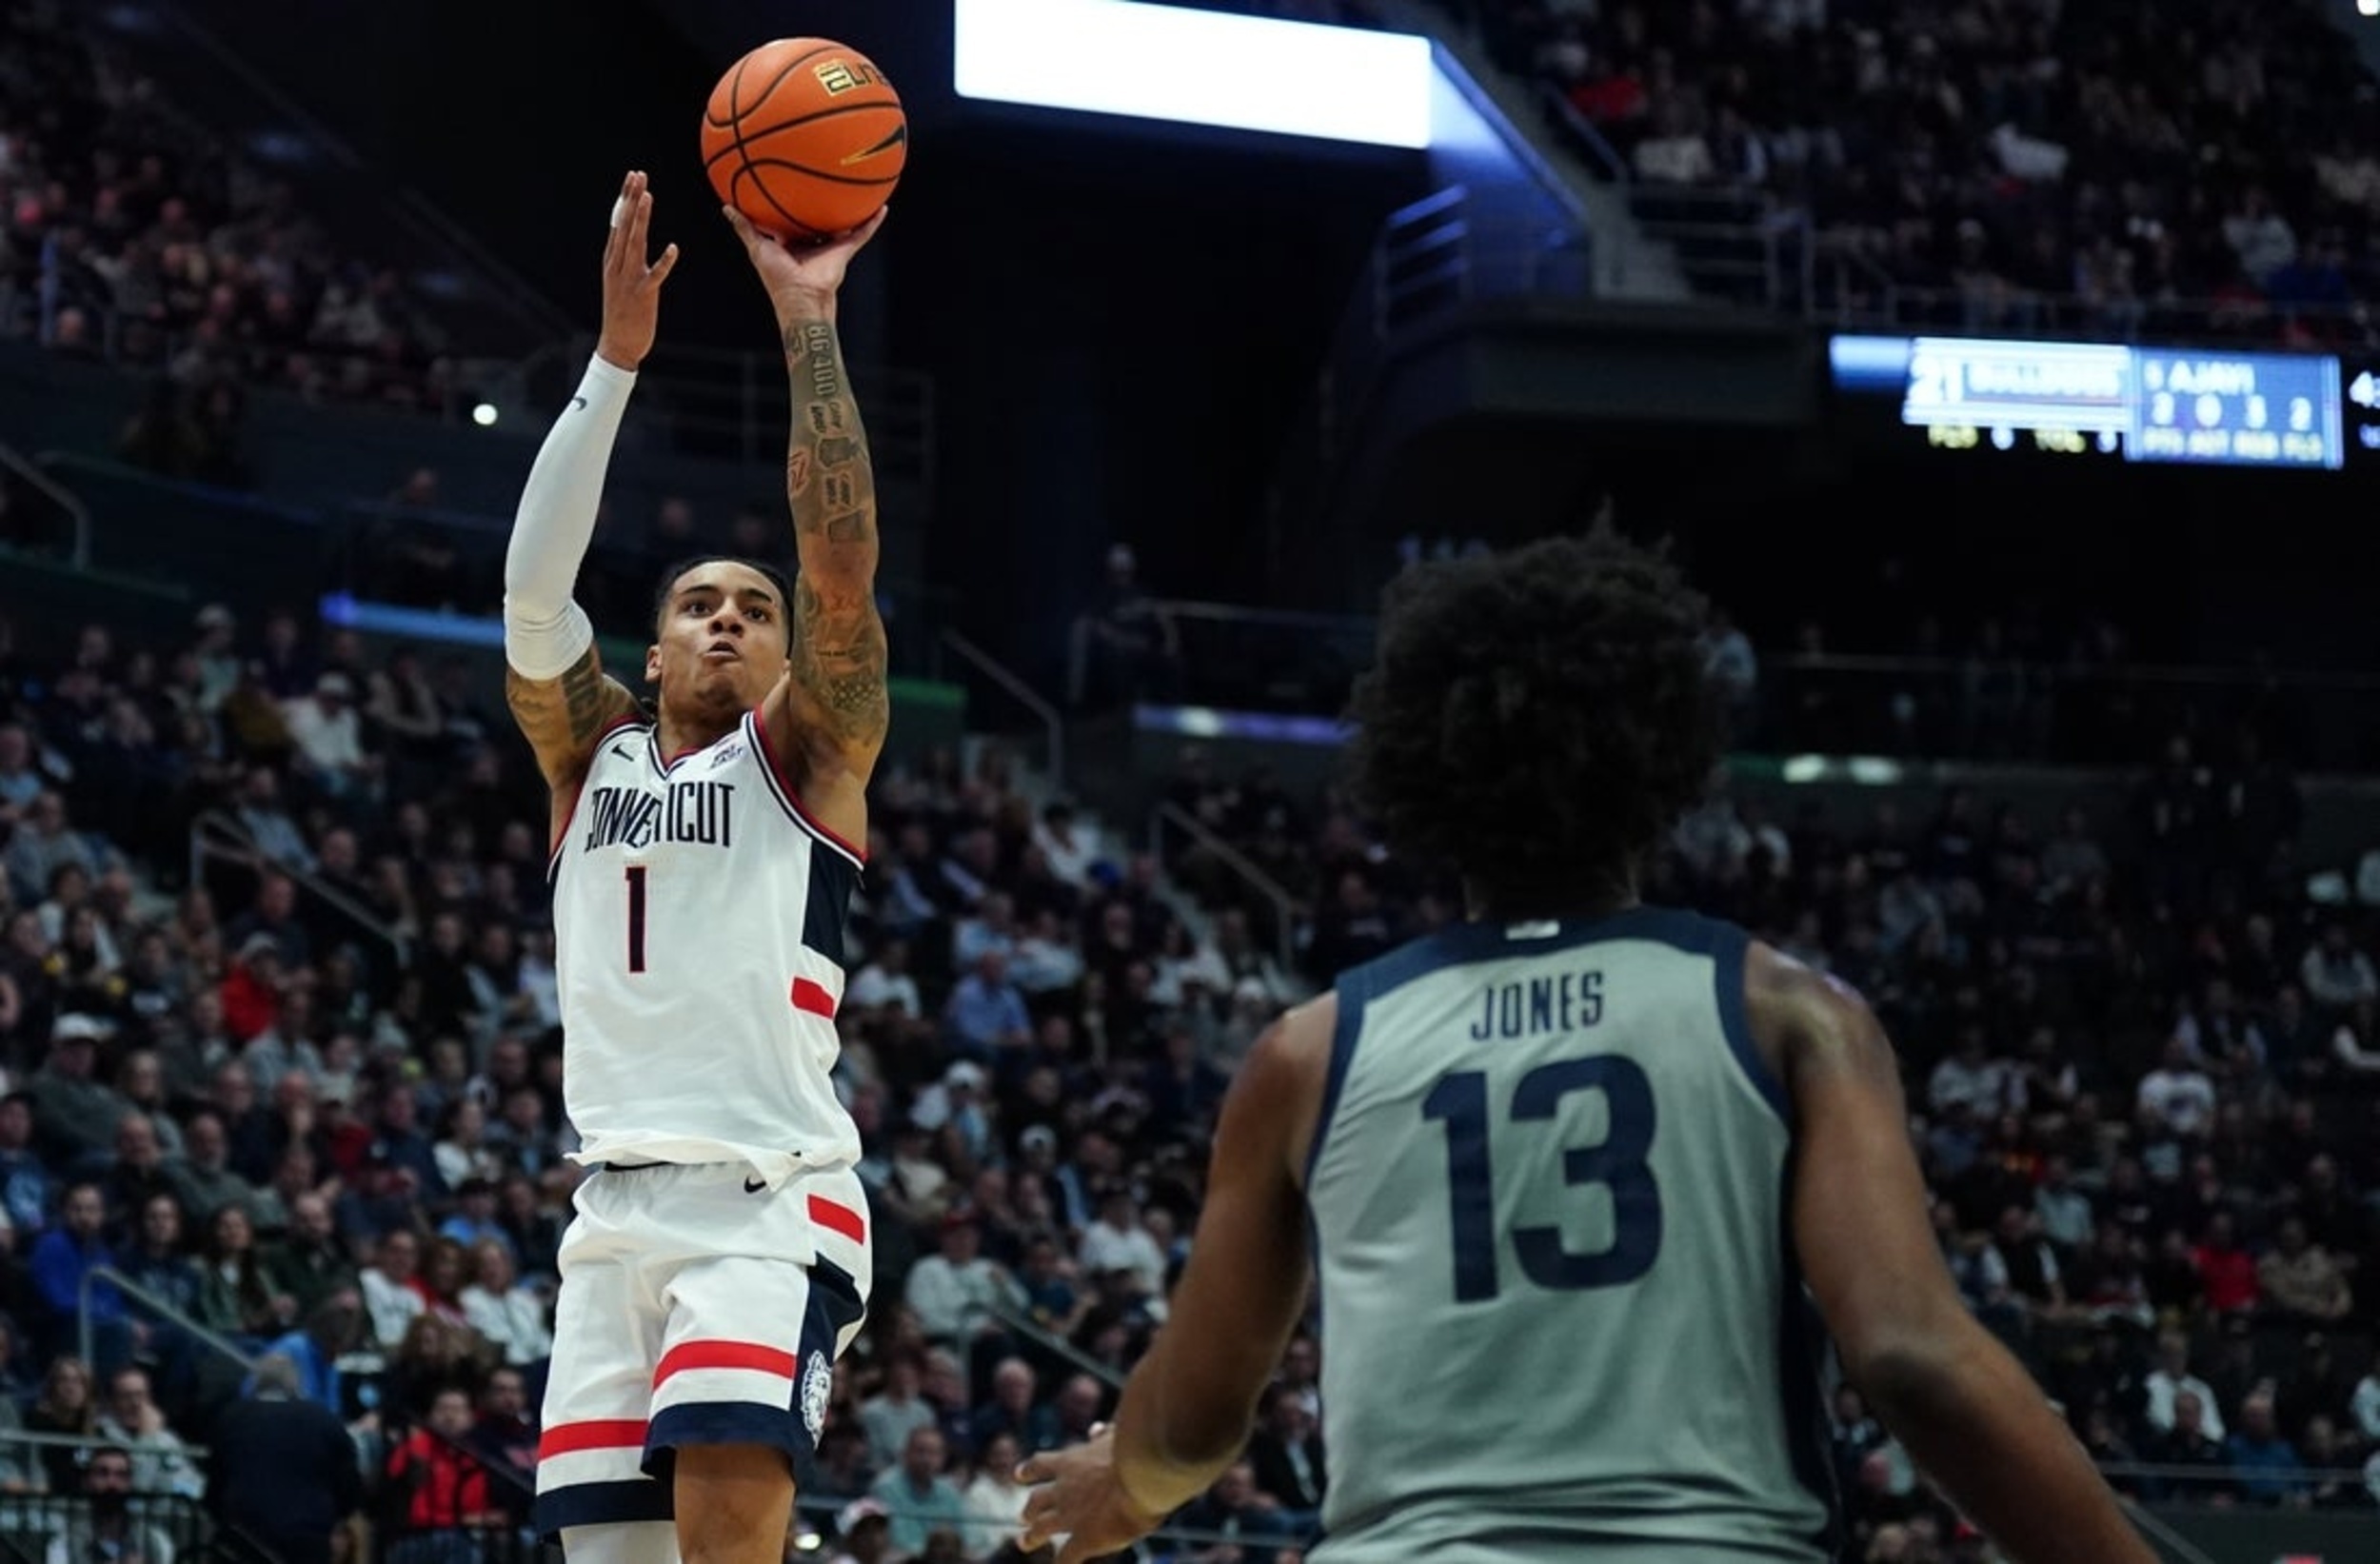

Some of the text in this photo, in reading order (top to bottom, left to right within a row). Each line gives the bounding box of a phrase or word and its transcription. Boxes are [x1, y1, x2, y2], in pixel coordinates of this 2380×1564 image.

[625, 865, 647, 973] 1
[1470, 970, 1604, 1041] JONES
[1421, 1053, 1664, 1305] 13
